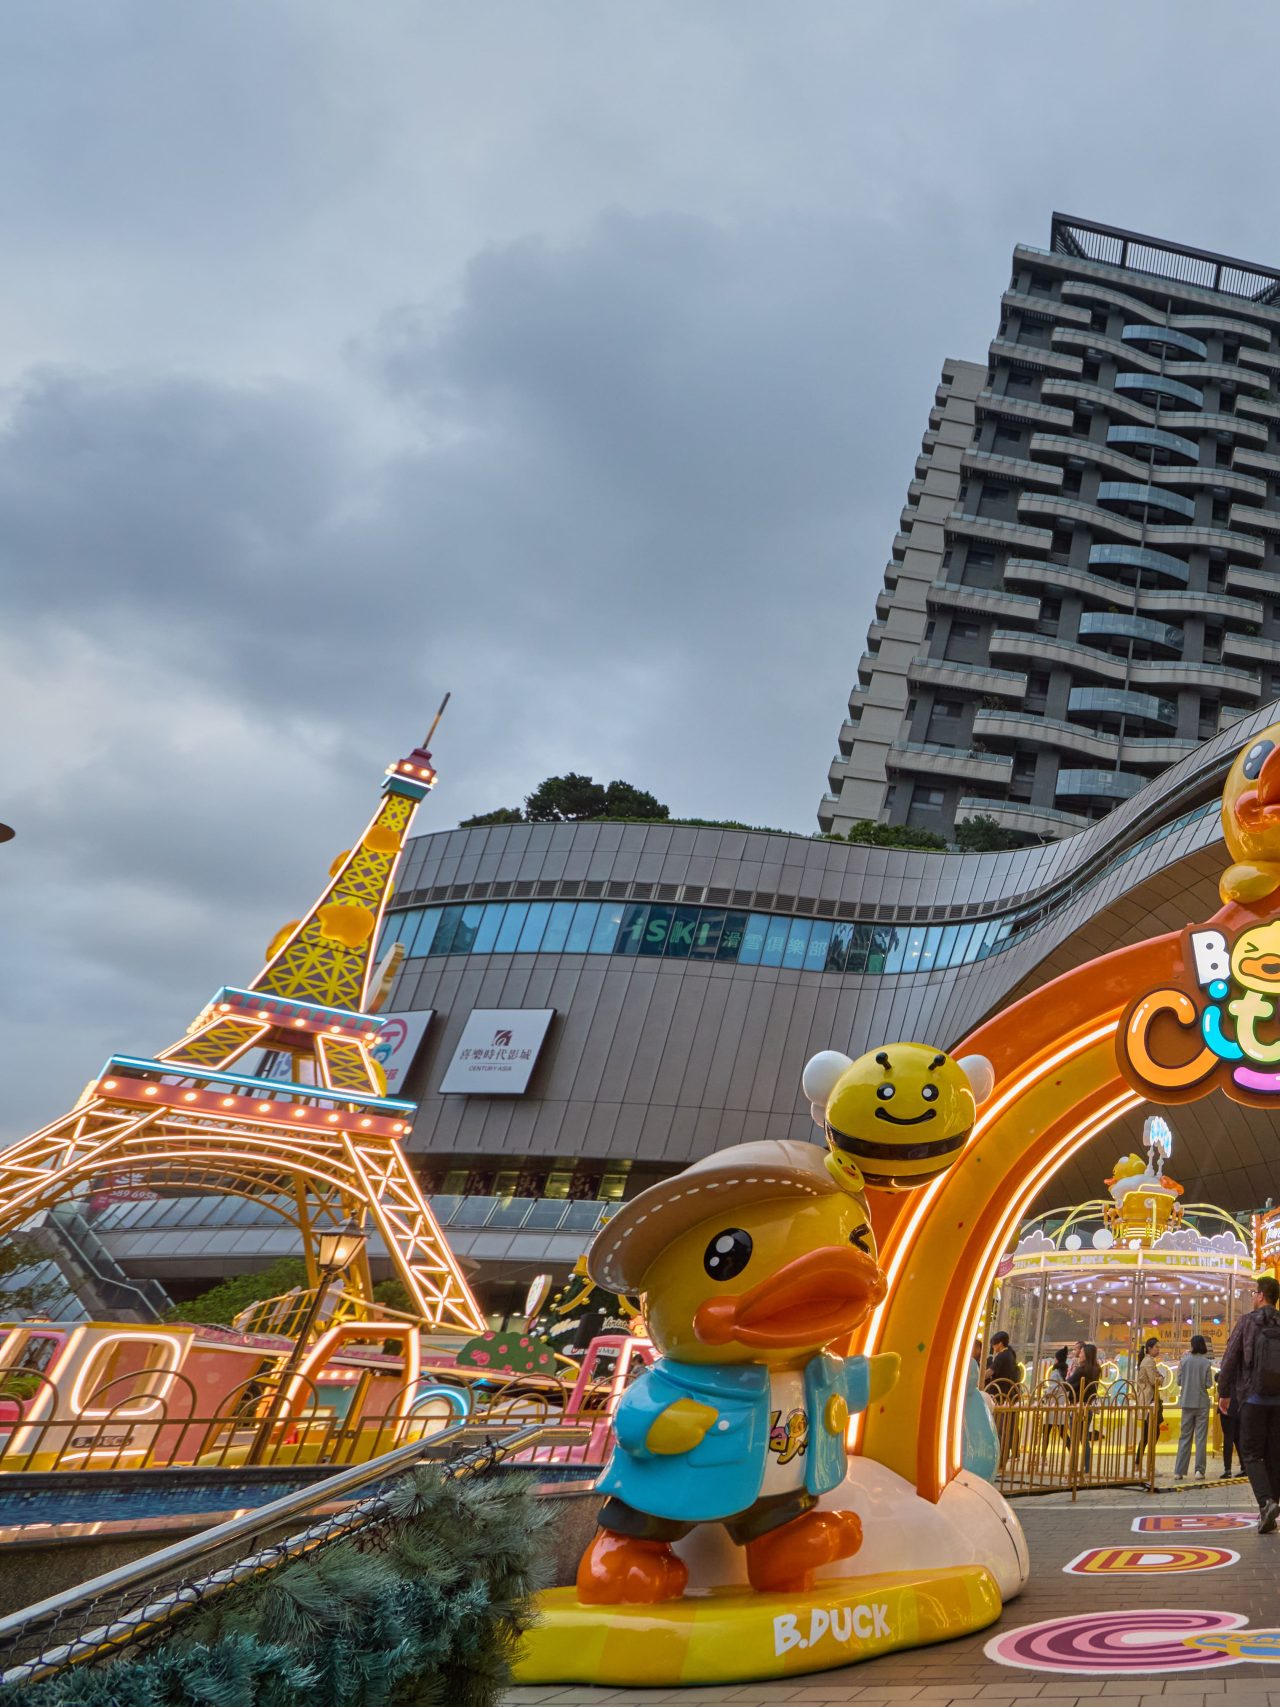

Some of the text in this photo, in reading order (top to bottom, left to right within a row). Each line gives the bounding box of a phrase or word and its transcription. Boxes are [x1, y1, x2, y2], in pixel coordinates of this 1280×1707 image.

[632, 917, 710, 946] iSKI
[459, 1049, 532, 1061] 喜樂時代影城
[773, 1603, 891, 1656] B.DUCK
